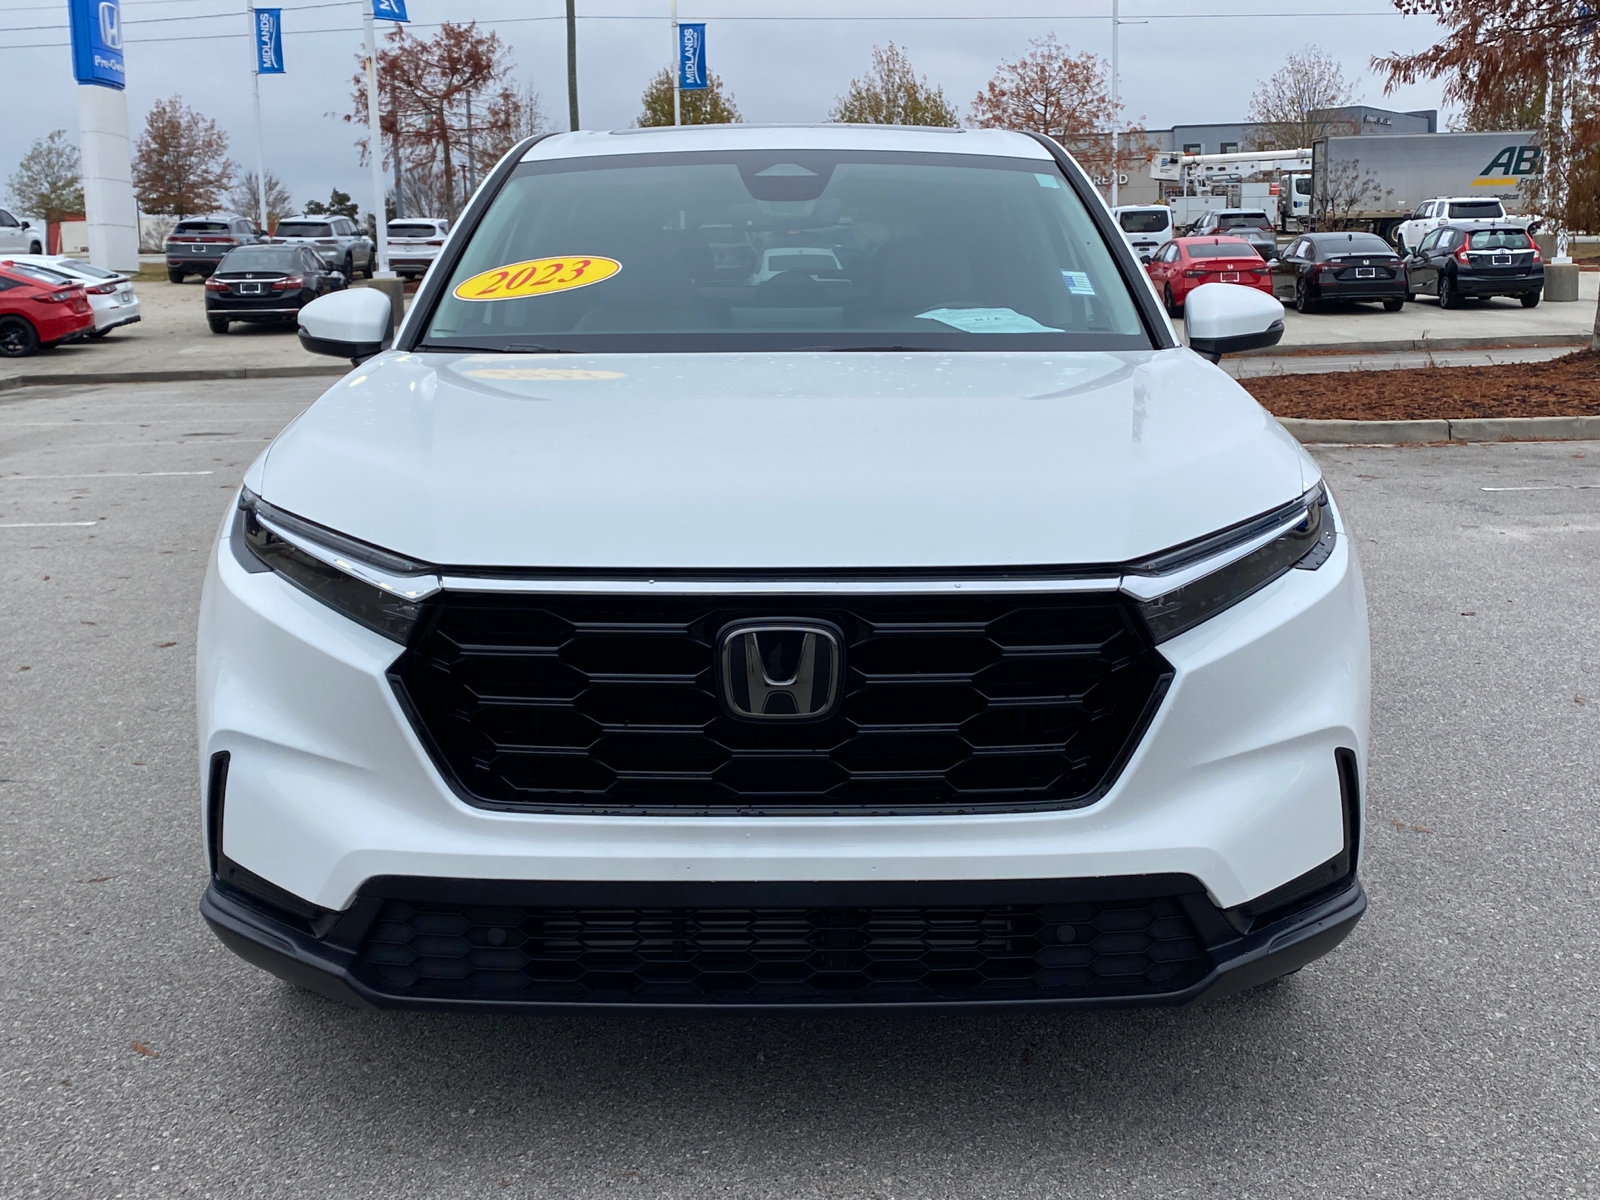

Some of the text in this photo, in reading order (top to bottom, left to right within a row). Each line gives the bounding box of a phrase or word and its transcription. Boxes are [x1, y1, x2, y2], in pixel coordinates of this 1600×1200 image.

[259, 13, 272, 68] MIDLANDS
[684, 28, 695, 84] MIDLANDS
[1090, 173, 1129, 185] RED
[475, 259, 592, 296] 2023
